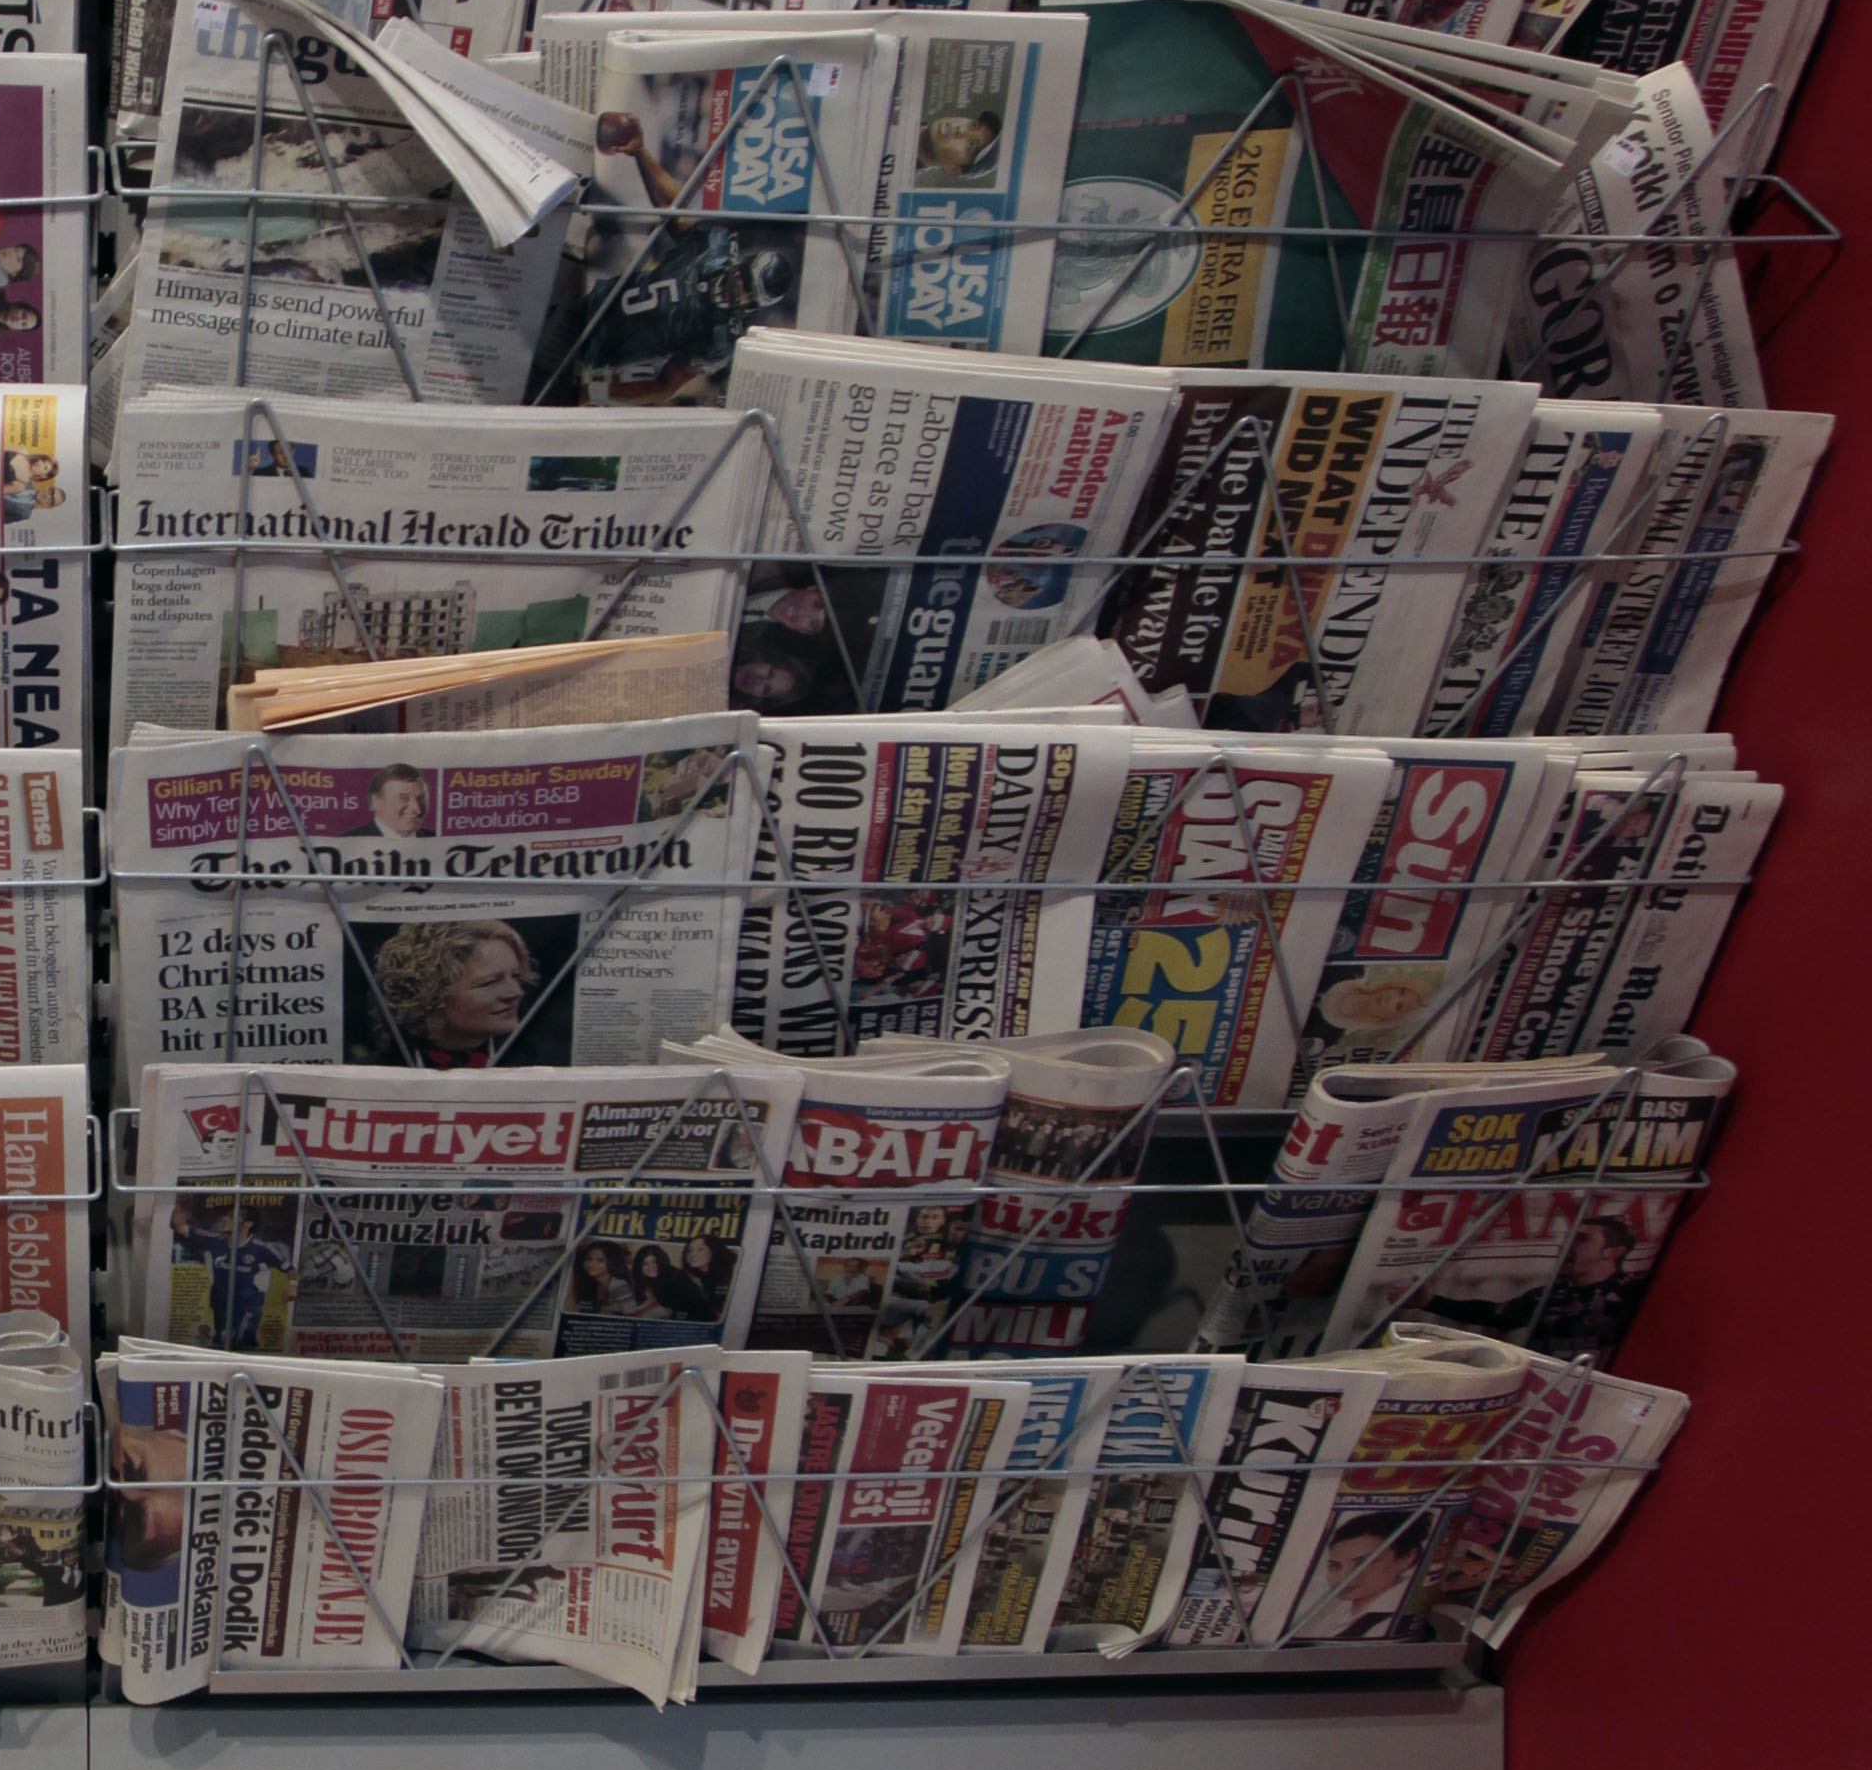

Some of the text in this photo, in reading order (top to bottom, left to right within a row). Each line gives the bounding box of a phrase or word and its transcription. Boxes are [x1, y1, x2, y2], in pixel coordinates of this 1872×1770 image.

[730, 81, 778, 205] TODAY
[768, 119, 810, 200] USA
[1051, 408, 1097, 500] nativity
[1073, 409, 1128, 520] A modern
[135, 499, 392, 544] International
[399, 511, 530, 548] Herald
[132, 563, 216, 581] Copenhagen
[132, 580, 202, 594] bogs down
[130, 609, 214, 624] and disputes
[131, 594, 191, 607] in details
[154, 774, 223, 798] Gillian
[448, 760, 637, 789] Alastair Sawday
[448, 785, 580, 809] Britain’s B&B
[979, 744, 1038, 854] DAILY
[29, 775, 51, 847] Temse
[446, 809, 549, 830] revolution
[1371, 769, 1488, 953] Sun
[278, 1108, 565, 1164] Hürriyet
